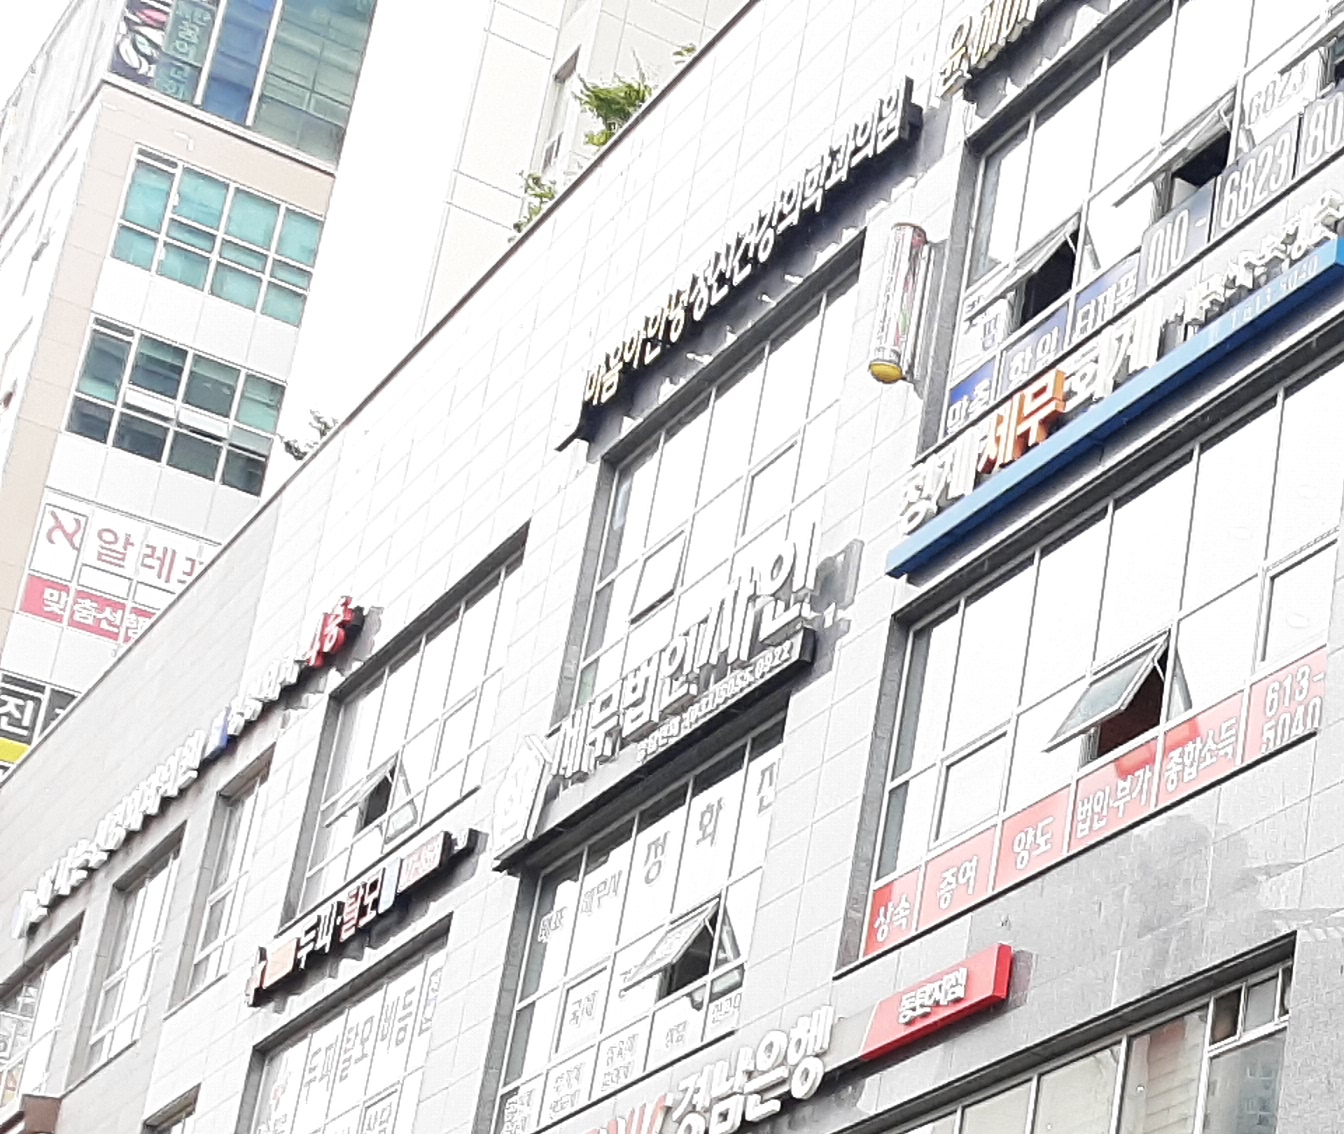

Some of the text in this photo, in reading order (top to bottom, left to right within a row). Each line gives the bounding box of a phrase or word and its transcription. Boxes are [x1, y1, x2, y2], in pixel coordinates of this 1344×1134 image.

[873, 894, 915, 946] 상속
[936, 853, 981, 913] 증여
[1012, 814, 1057, 873] 양도
